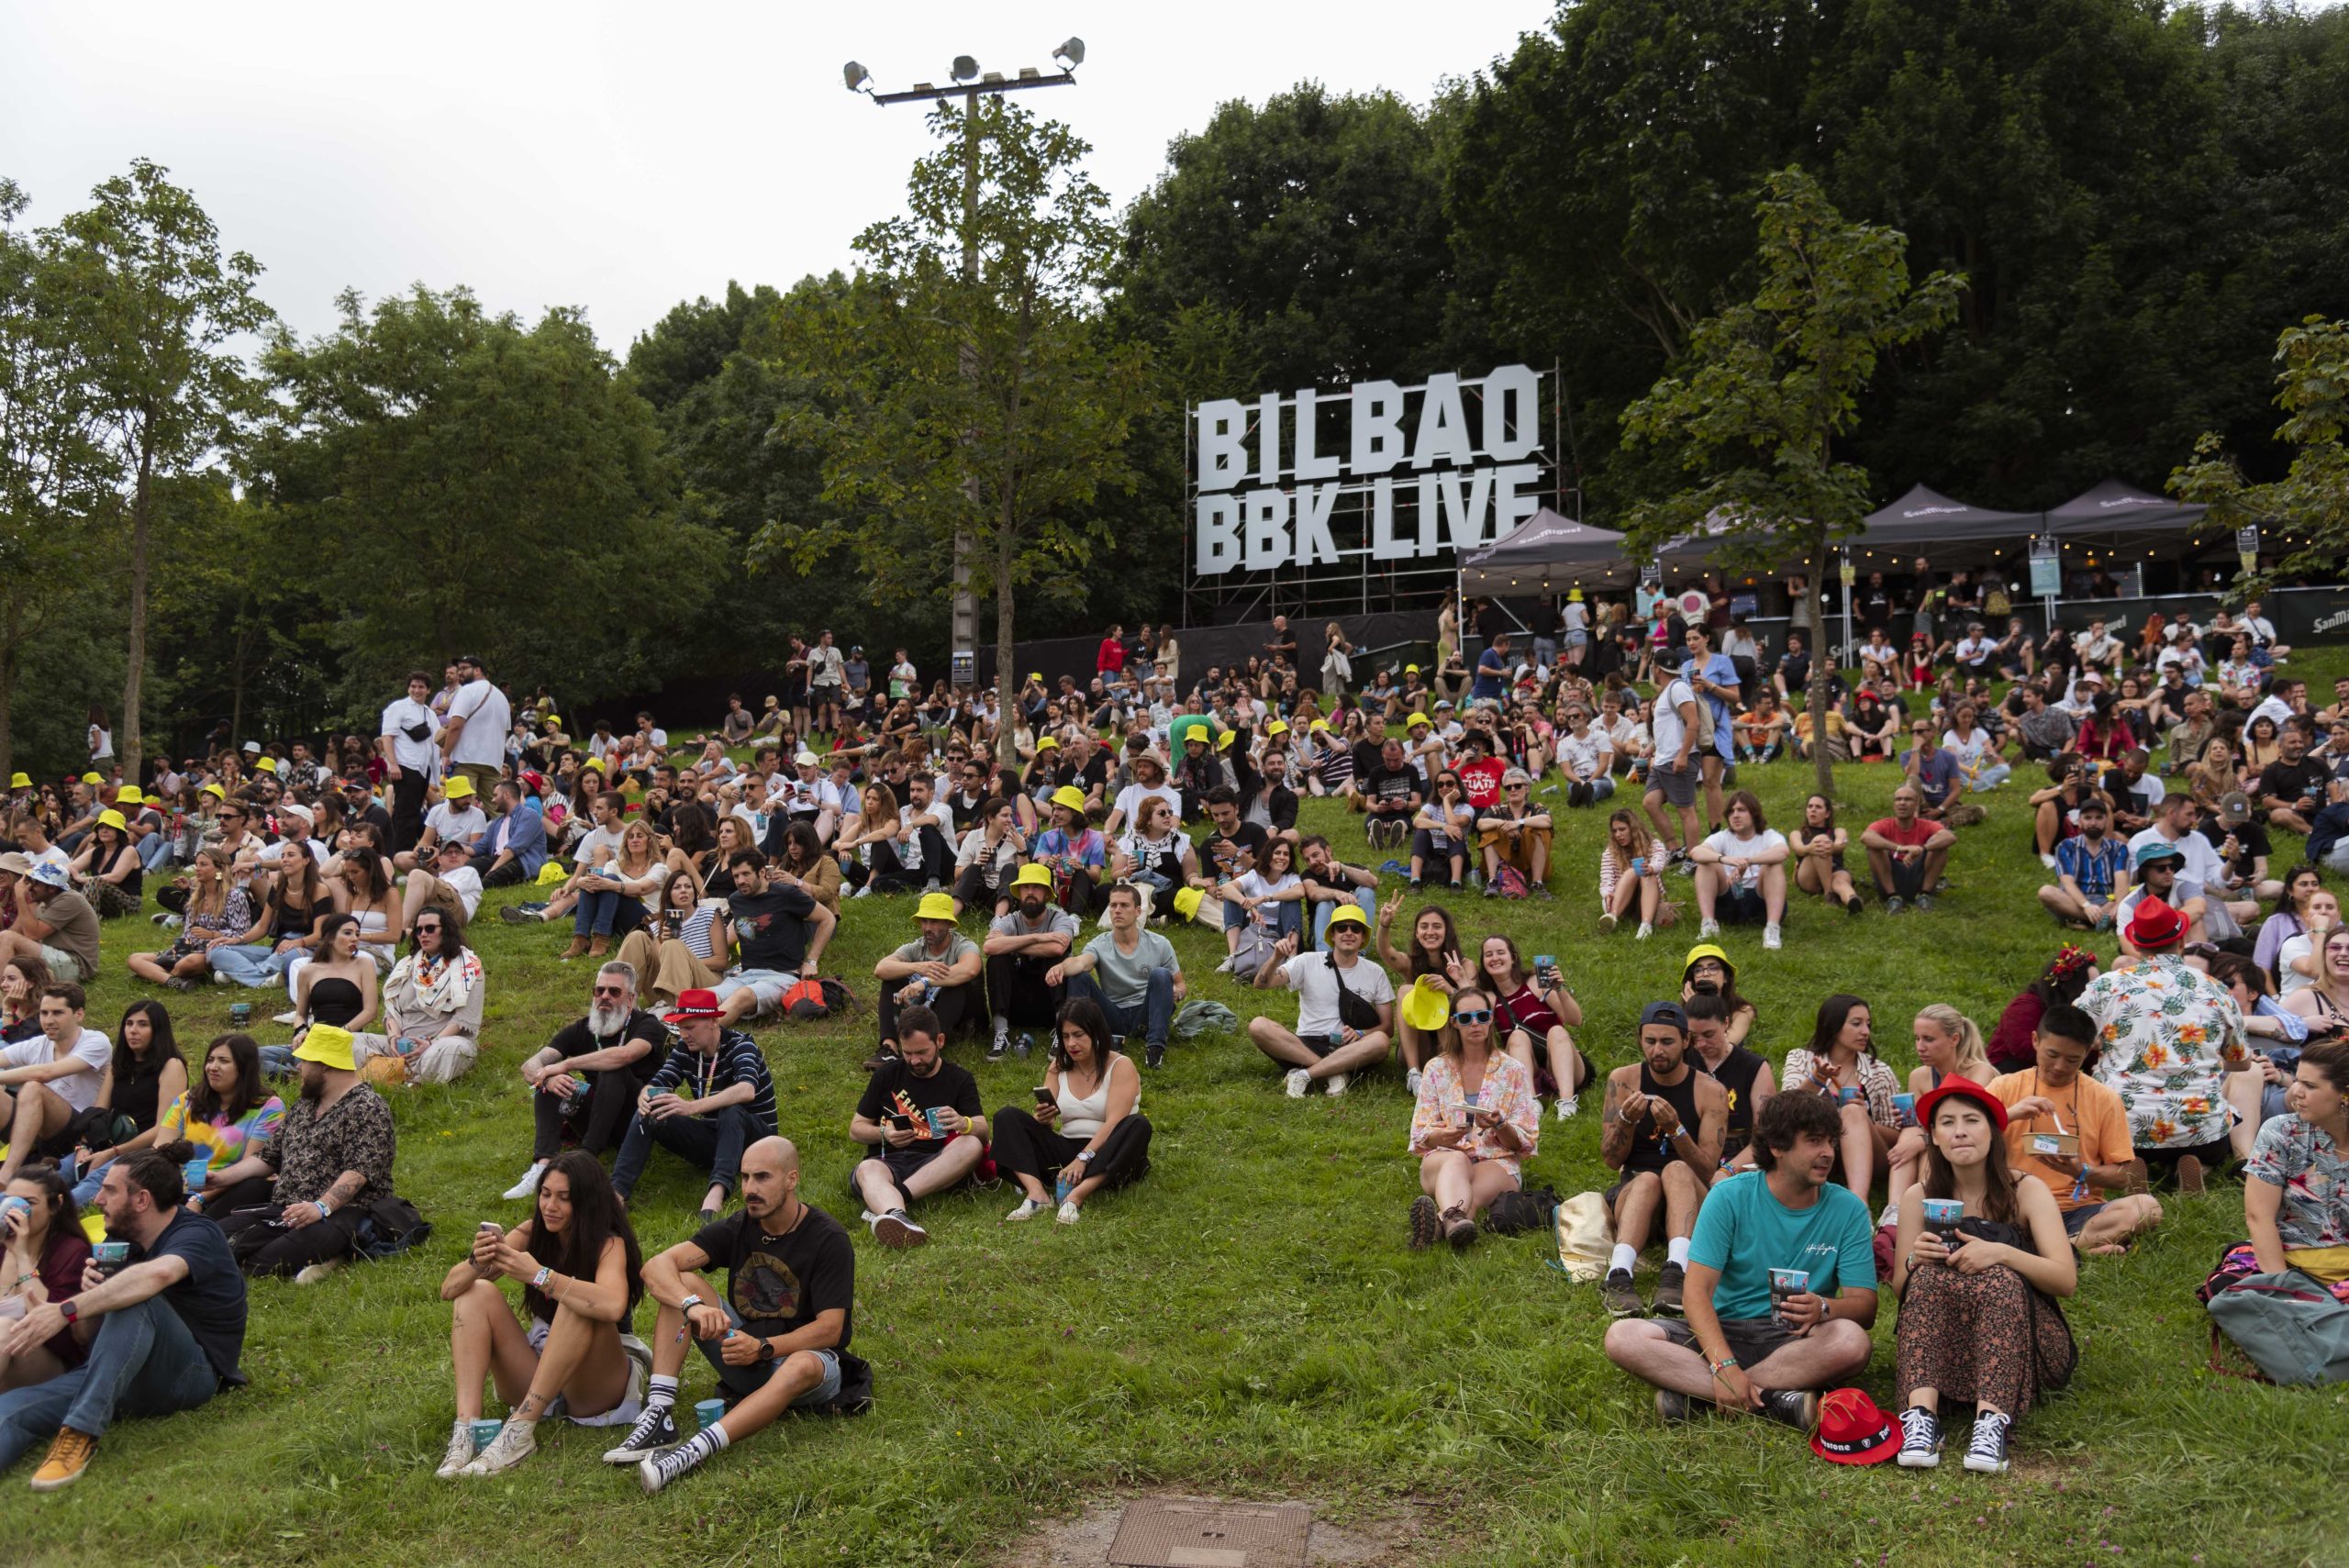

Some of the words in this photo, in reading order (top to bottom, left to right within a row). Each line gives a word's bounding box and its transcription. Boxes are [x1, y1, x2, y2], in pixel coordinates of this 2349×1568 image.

[1197, 363, 1539, 492] BILBAO
[1197, 482, 1341, 576] BBK
[1373, 463, 1540, 560] LIVE
[895, 1088, 927, 1122] FRANZ
